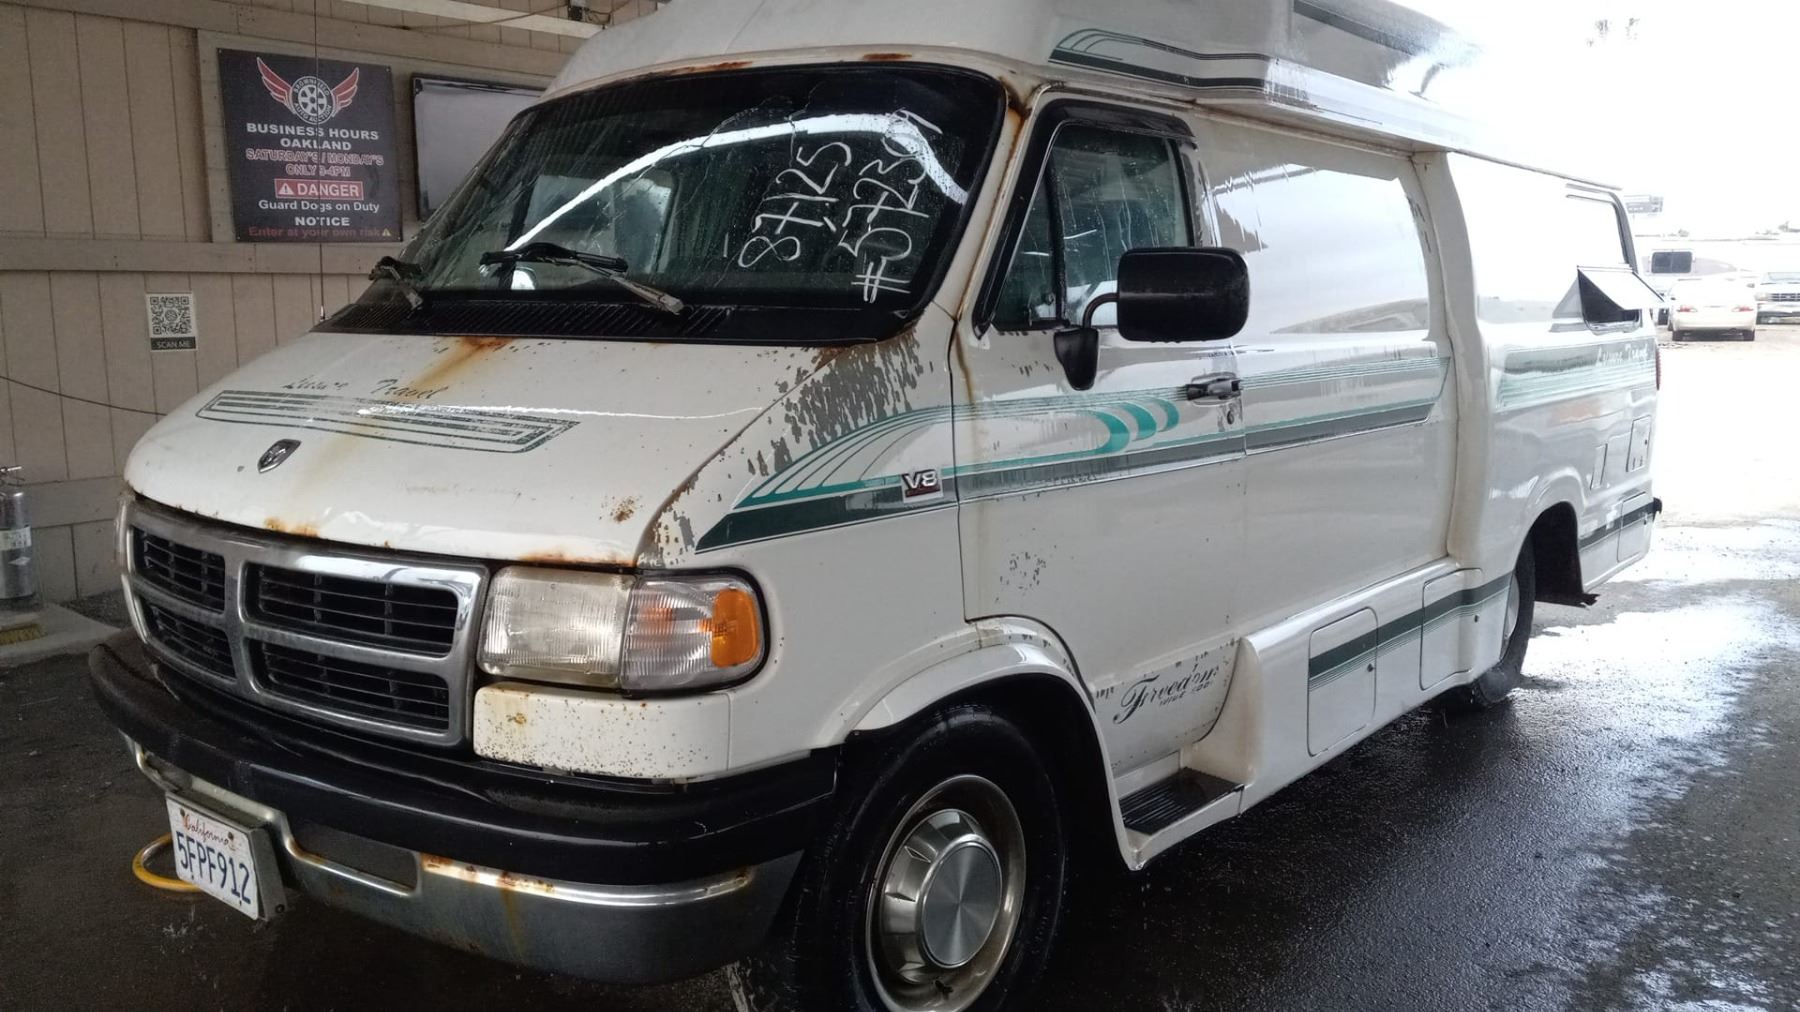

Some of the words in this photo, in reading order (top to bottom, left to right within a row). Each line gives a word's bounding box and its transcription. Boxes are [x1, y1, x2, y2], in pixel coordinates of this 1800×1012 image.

[246, 122, 325, 137] BUSINESS
[328, 127, 379, 141] HOURS
[279, 137, 352, 151] OAKLAND
[285, 163, 317, 176] ONLY
[296, 182, 360, 198] DANGER
[258, 199, 298, 211] Guard
[301, 200, 333, 213] Dogs
[335, 203, 351, 211] on
[353, 201, 380, 214] Duty
[294, 216, 351, 227] NOTICE
[248, 226, 283, 237] Enter
[902, 469, 938, 490] V8
[176, 831, 251, 904] 5FPF912
